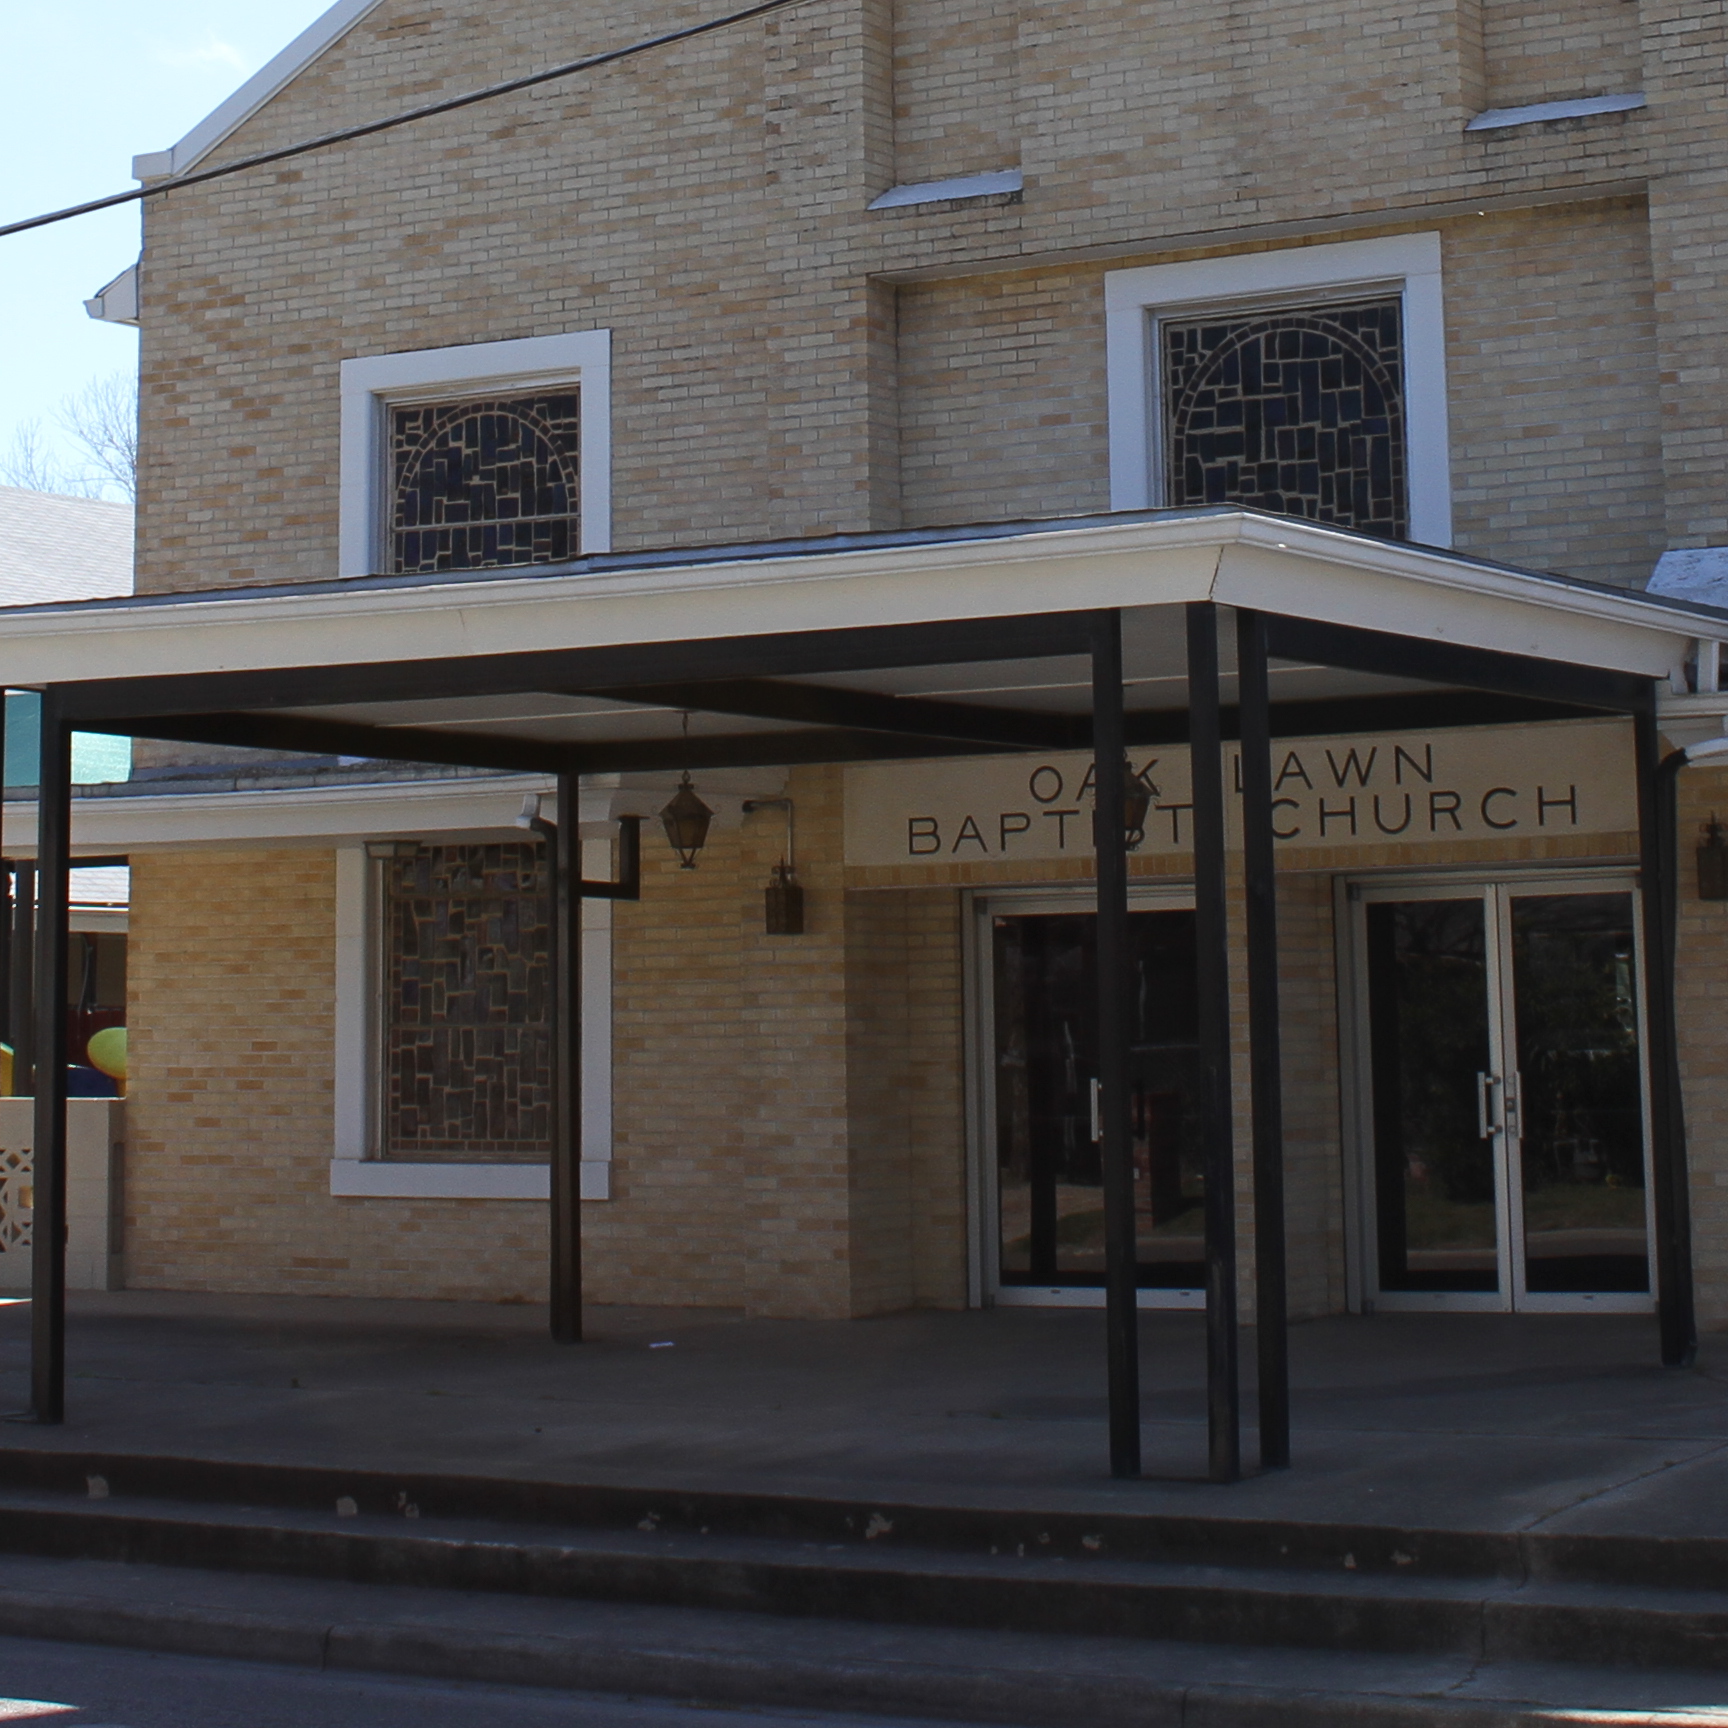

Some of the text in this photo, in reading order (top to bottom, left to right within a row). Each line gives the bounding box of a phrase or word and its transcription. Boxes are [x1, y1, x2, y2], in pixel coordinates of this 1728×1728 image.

[1233, 743, 1433, 794] LAWN
[908, 784, 1578, 855] BAPTIT CHURCH
